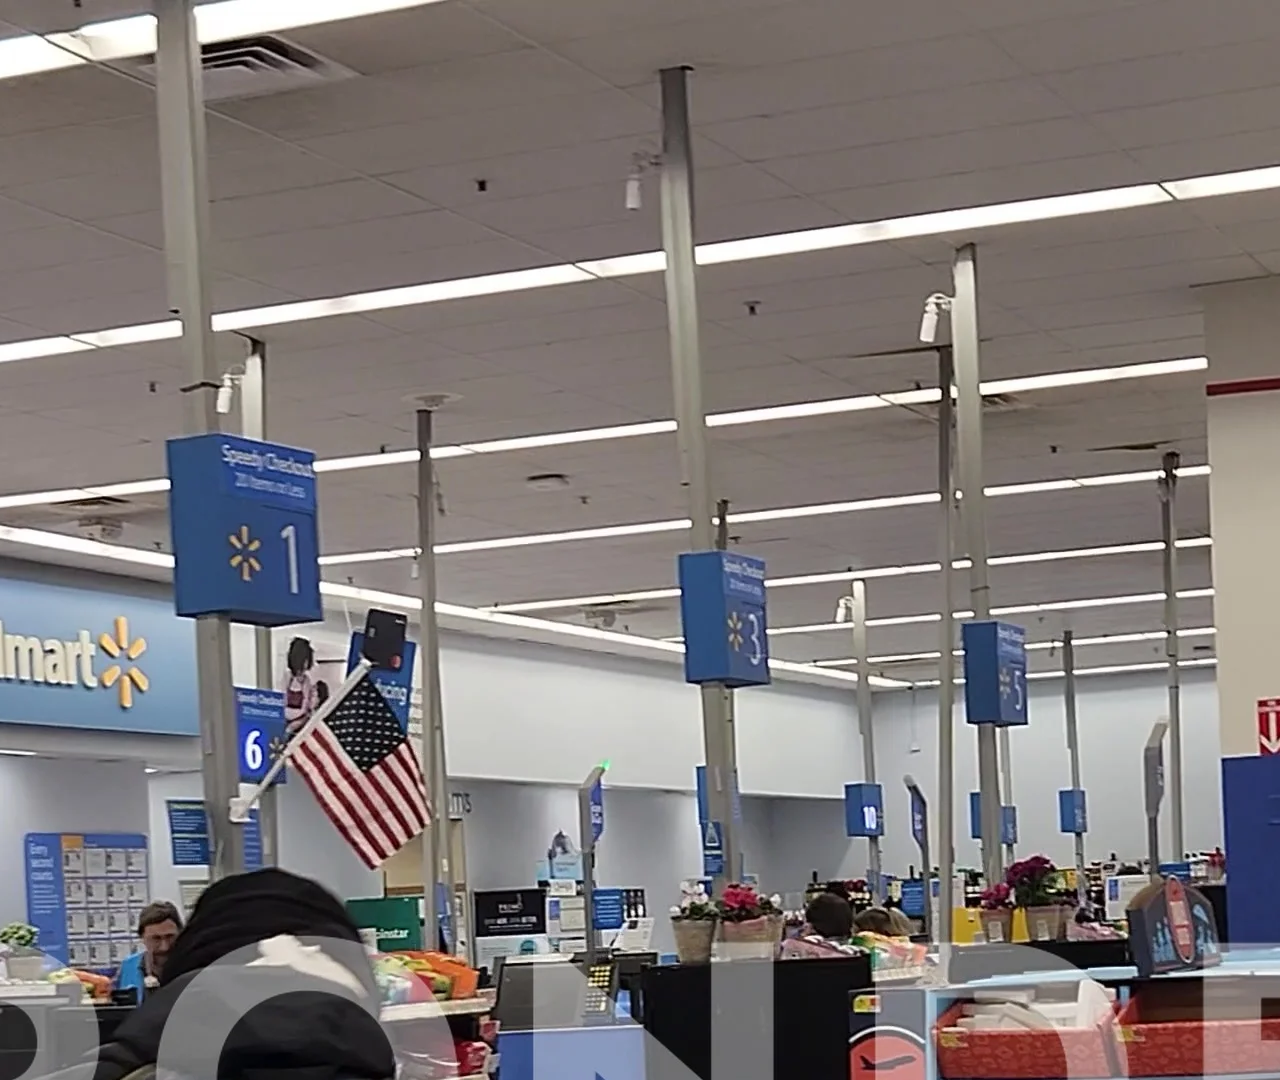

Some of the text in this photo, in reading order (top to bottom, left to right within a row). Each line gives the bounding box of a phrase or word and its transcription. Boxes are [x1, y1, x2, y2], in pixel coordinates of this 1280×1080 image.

[222, 445, 316, 478] Speedy Checkout
[281, 525, 298, 594] 1
[748, 613, 761, 666] 3
[1014, 669, 1023, 711] 5
[245, 730, 263, 770] 6
[863, 806, 877, 830] 10
